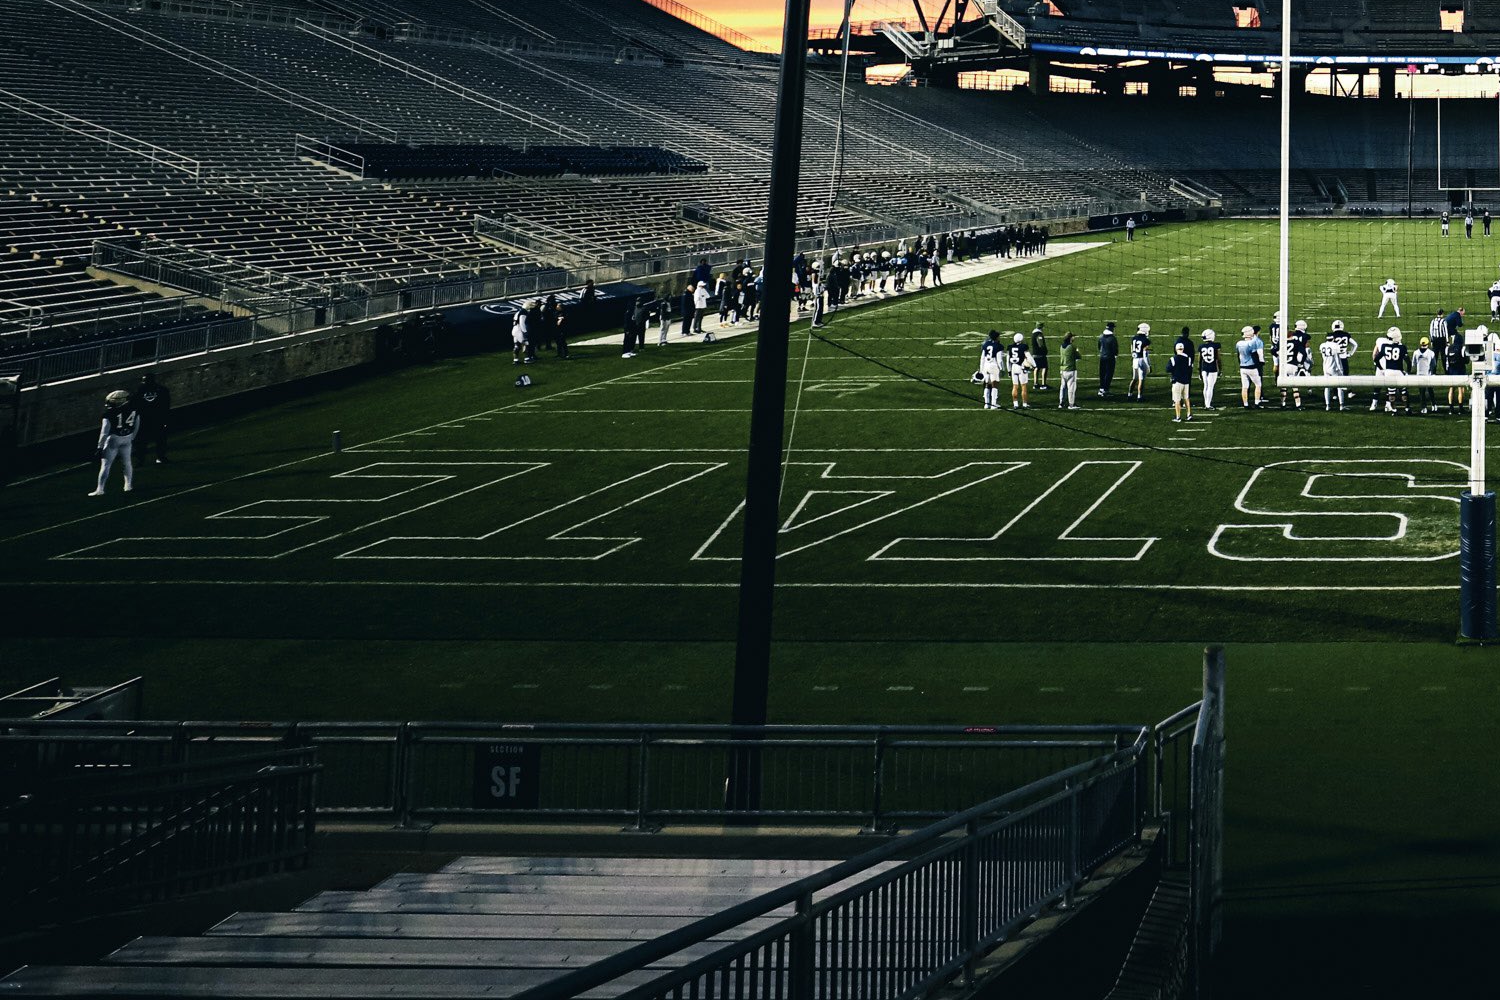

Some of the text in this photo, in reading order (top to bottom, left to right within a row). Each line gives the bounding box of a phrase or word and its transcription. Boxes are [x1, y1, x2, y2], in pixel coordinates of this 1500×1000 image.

[1011, 347, 1019, 359] 5
[1132, 339, 1143, 353] 13
[1201, 346, 1215, 360] 29
[1384, 346, 1400, 360] 58
[116, 410, 137, 429] 14
[490, 745, 524, 754] SECTION
[490, 765, 521, 798] SF
